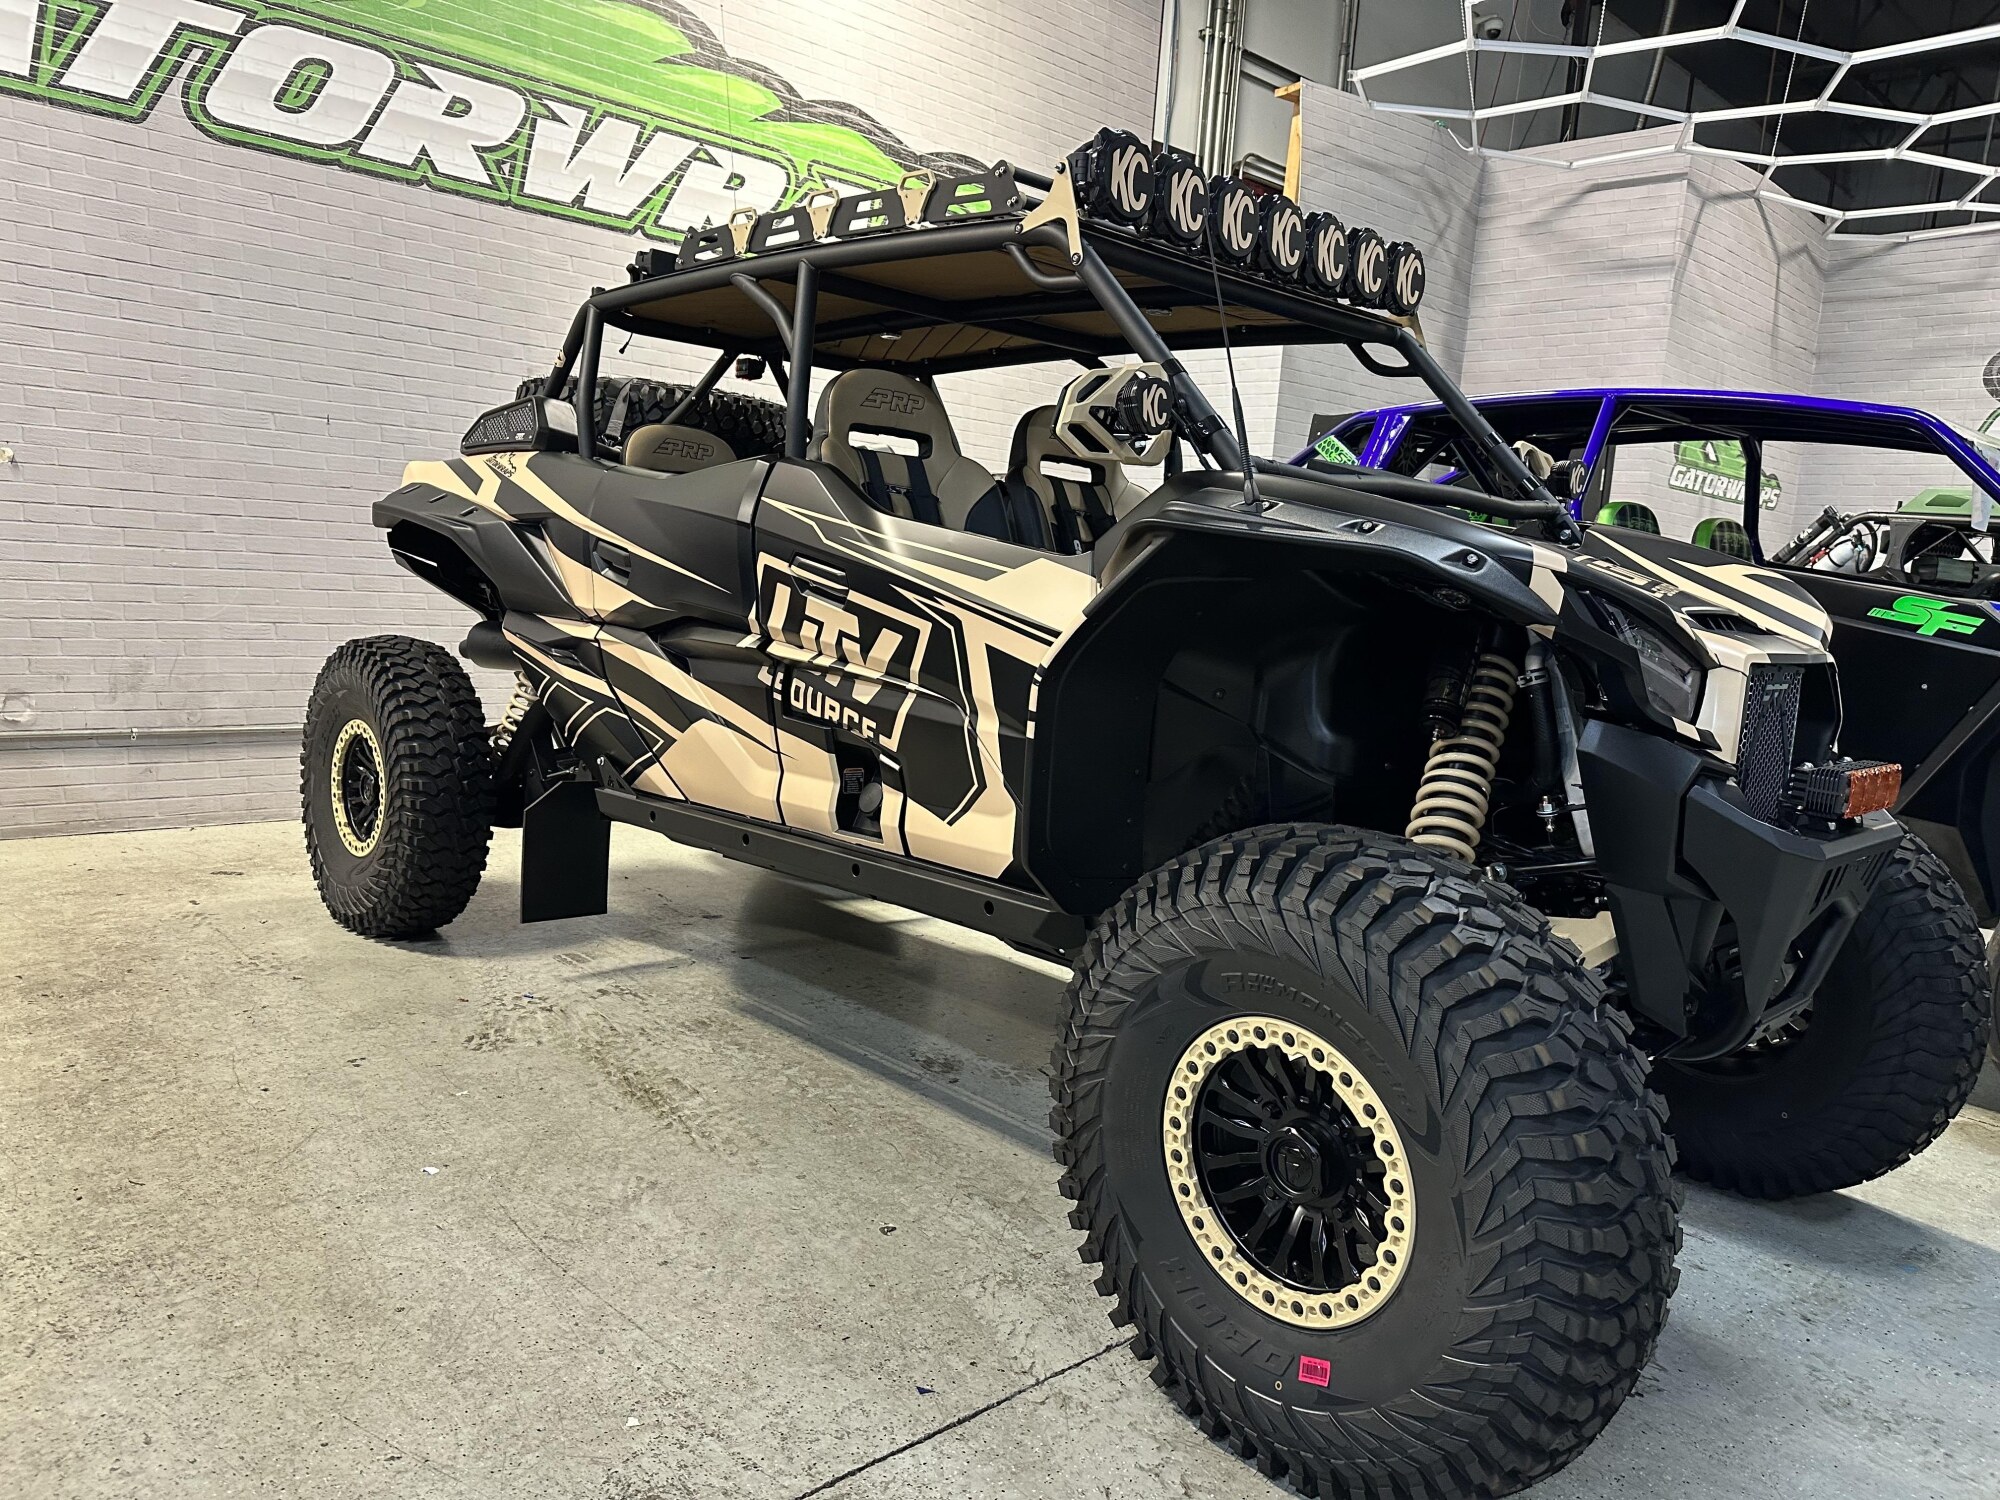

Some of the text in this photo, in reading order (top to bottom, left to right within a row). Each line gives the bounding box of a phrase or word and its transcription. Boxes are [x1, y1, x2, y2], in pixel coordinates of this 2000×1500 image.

[1110, 144, 1149, 213] KC
[1170, 168, 1205, 233] KC
[1222, 188, 1255, 251] KC
[1271, 207, 1302, 267] KC
[1317, 224, 1345, 282] KC
[1357, 238, 1385, 294] KC
[1396, 252, 1422, 306] KC
[860, 387, 926, 415] PRP
[1142, 383, 1168, 428] KC
[652, 437, 715, 461] PRP
[1570, 464, 1585, 494] KC
[1669, 464, 1781, 509] GATORWPS
[1866, 595, 1986, 636] SF
[766, 582, 904, 705] UTV
